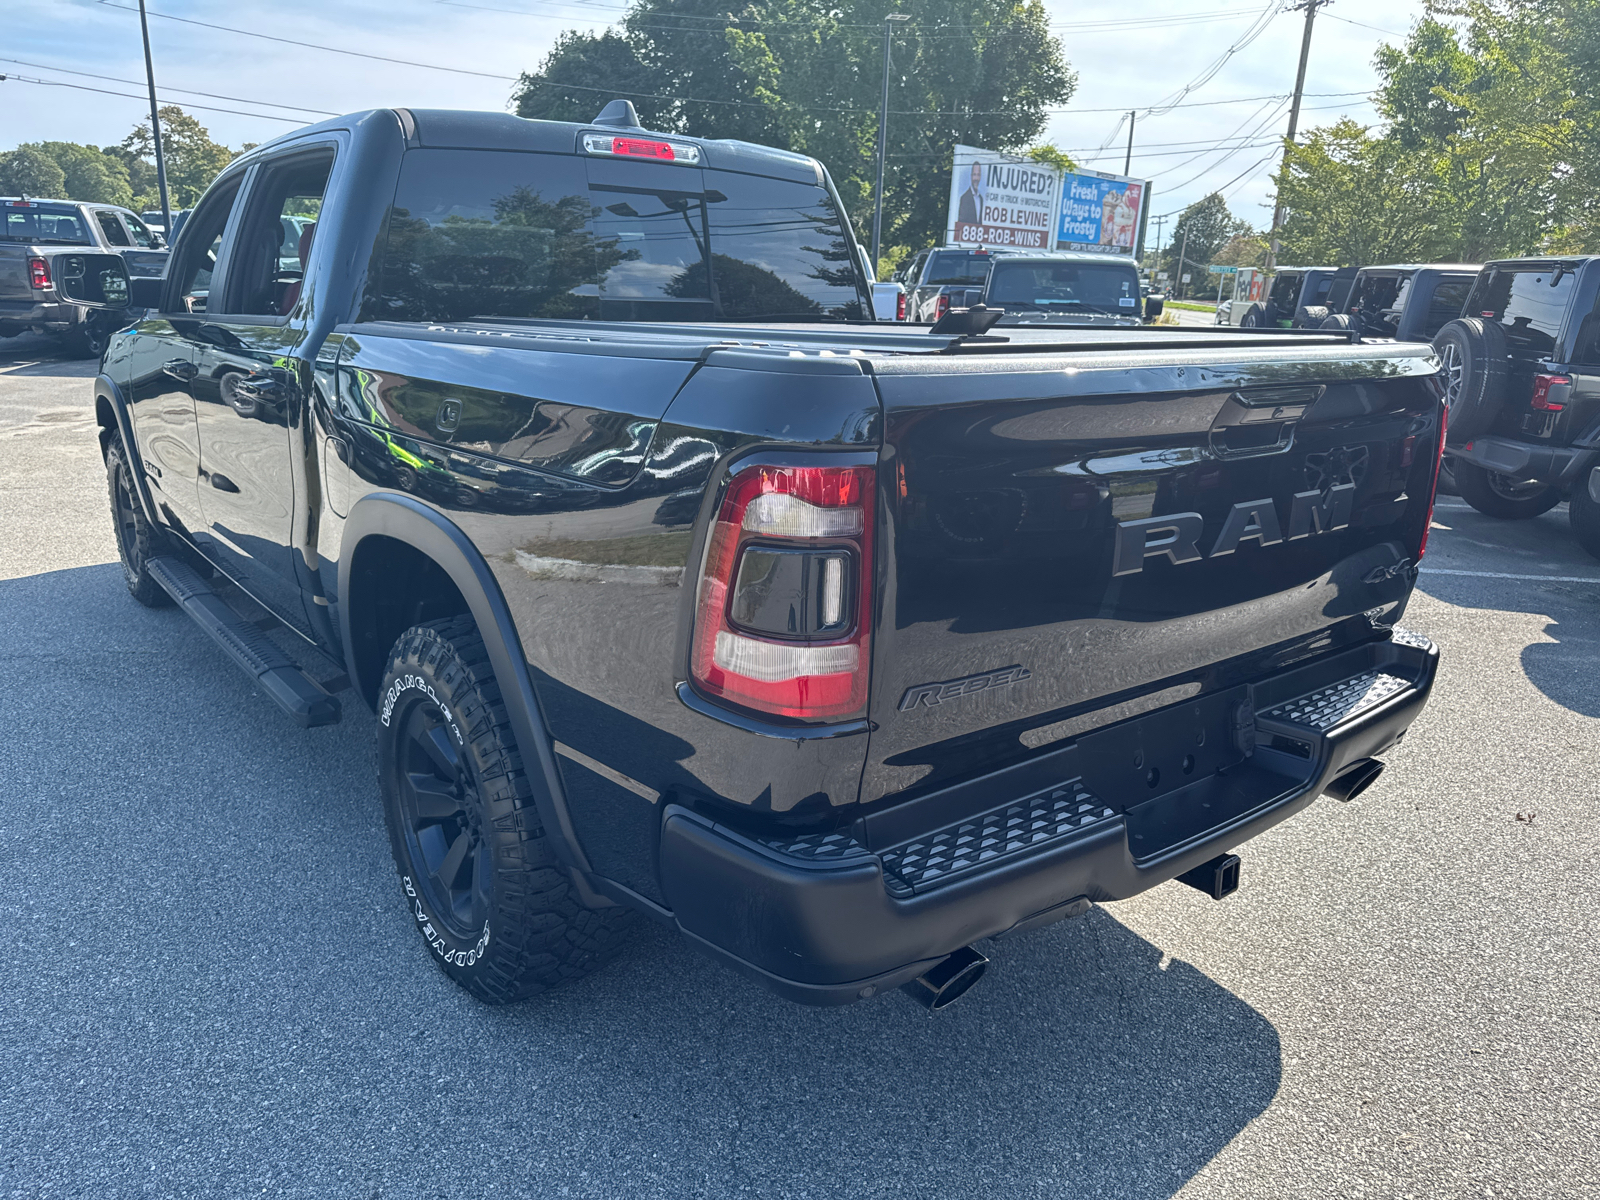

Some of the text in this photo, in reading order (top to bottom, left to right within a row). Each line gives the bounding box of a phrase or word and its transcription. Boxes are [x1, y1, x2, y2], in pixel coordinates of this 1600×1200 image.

[986, 164, 1053, 196] INJURED?
[1070, 181, 1098, 201] Fresh
[984, 206, 1049, 227] ROB LEVINE
[1062, 198, 1102, 221] Ways to
[962, 225, 1041, 246] 888-ROB-WINS
[1063, 217, 1097, 240] Frosty
[1112, 482, 1356, 577] RAM
[897, 663, 1033, 713] REBEL
[381, 674, 464, 746] WRANGLER
[403, 876, 490, 967] GOODYEAR
